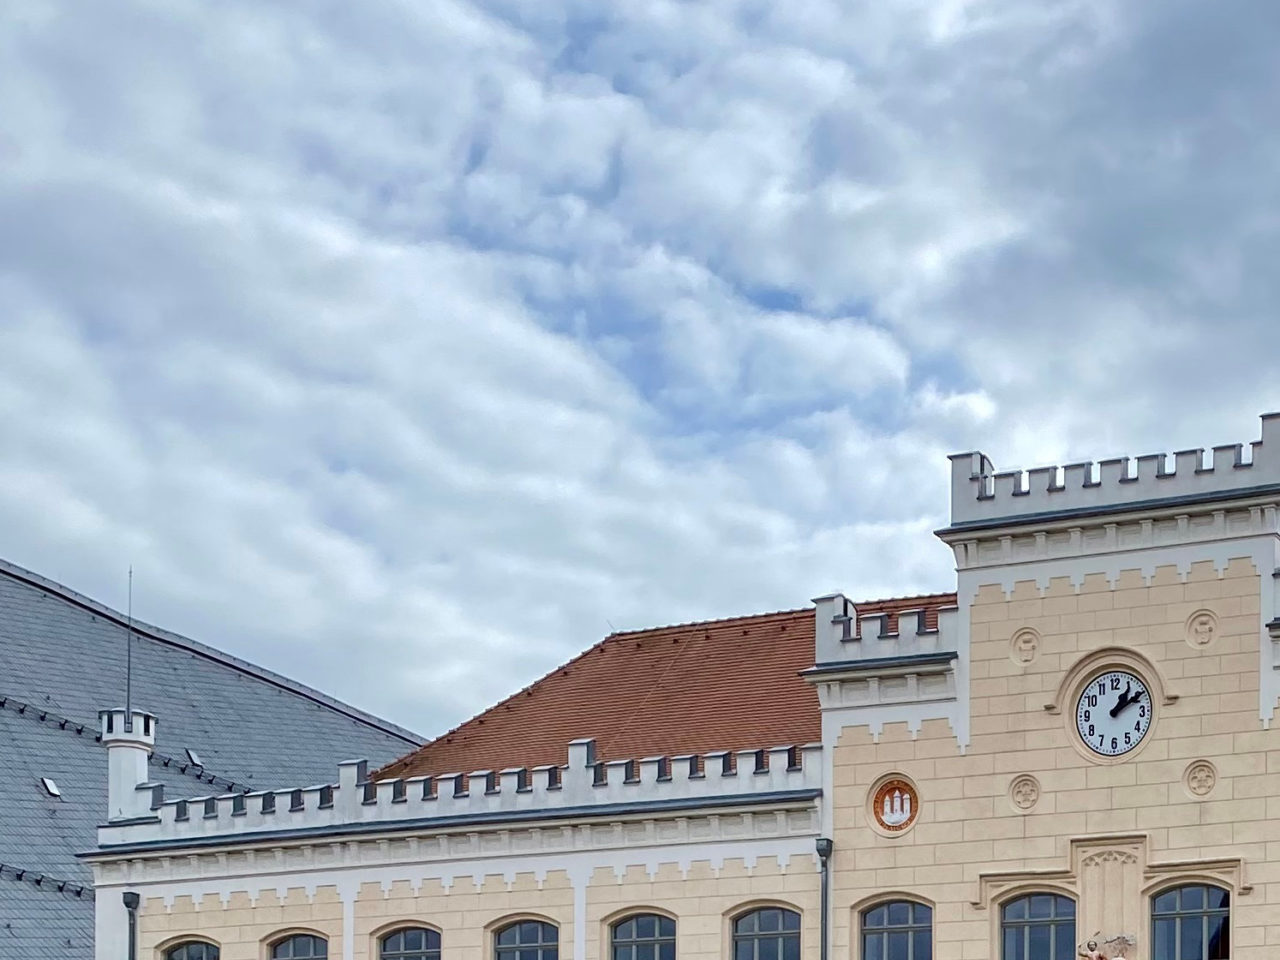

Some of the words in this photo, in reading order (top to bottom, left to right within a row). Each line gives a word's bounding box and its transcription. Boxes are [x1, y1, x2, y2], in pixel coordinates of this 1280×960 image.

[1099, 683, 1105, 695] 11
[1110, 678, 1120, 690] 12
[1085, 695, 1097, 707] 10
[1084, 710, 1090, 722] 9
[1139, 705, 1145, 717] 3
[1089, 725, 1094, 736] 8
[1134, 721, 1140, 732] 4
[1099, 735, 1104, 746] 7
[1111, 738, 1117, 749] 6
[1124, 732, 1130, 744] 5
